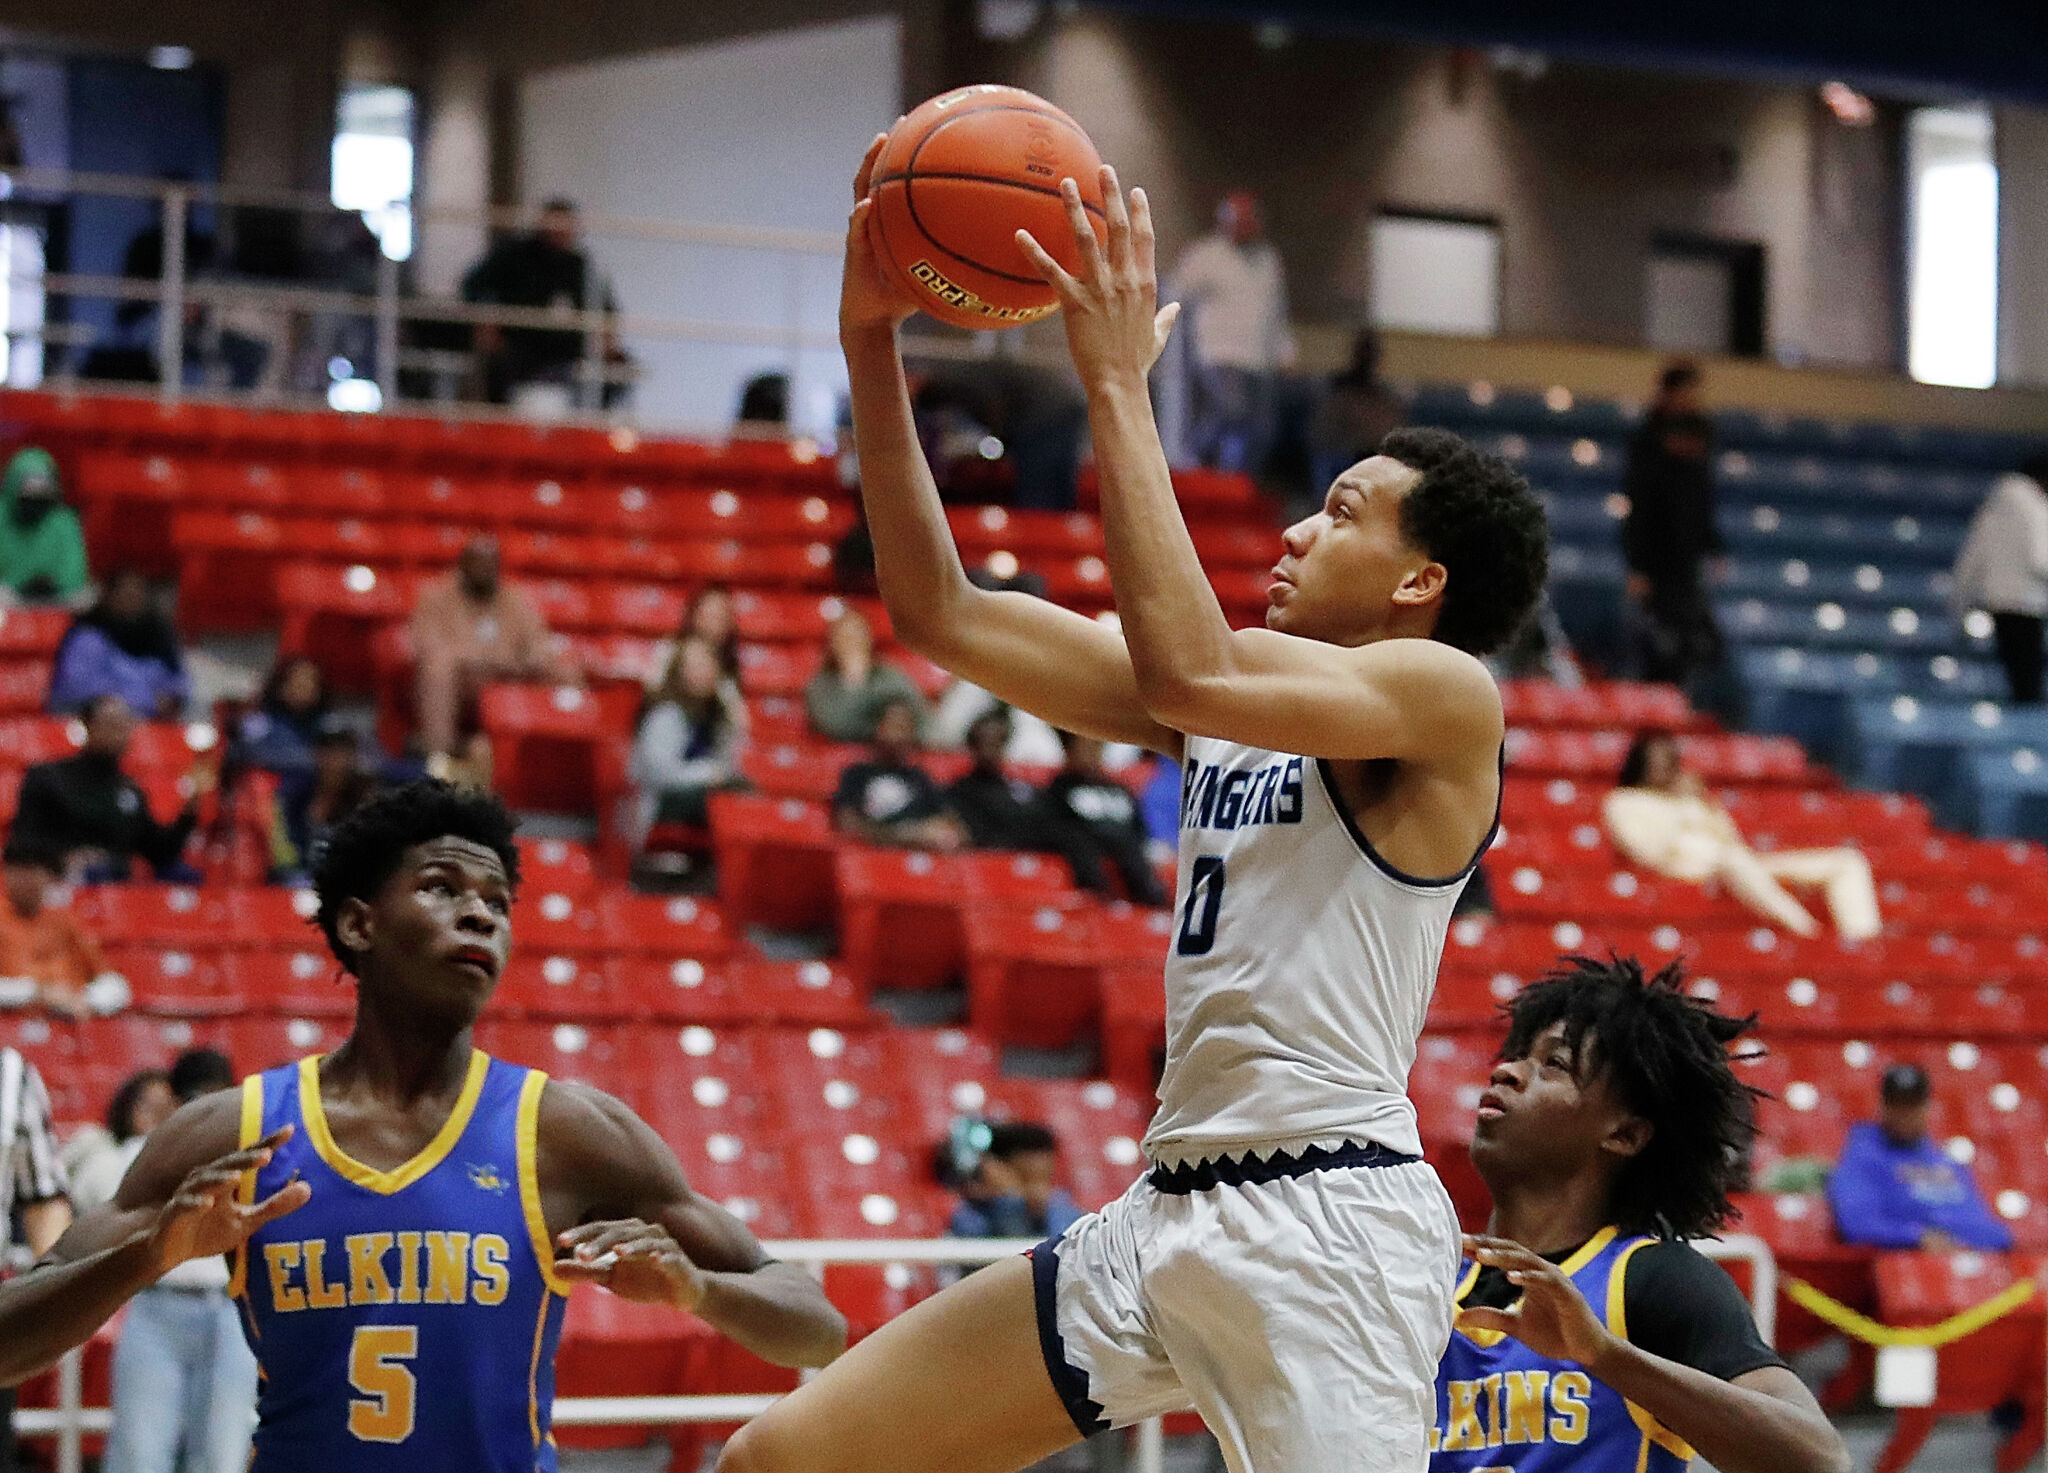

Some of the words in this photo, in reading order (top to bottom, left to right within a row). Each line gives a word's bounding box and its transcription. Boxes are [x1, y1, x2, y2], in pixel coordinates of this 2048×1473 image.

[1177, 855, 1226, 956] 0
[263, 1230, 511, 1313] ELKINS
[347, 1325, 419, 1444] 5
